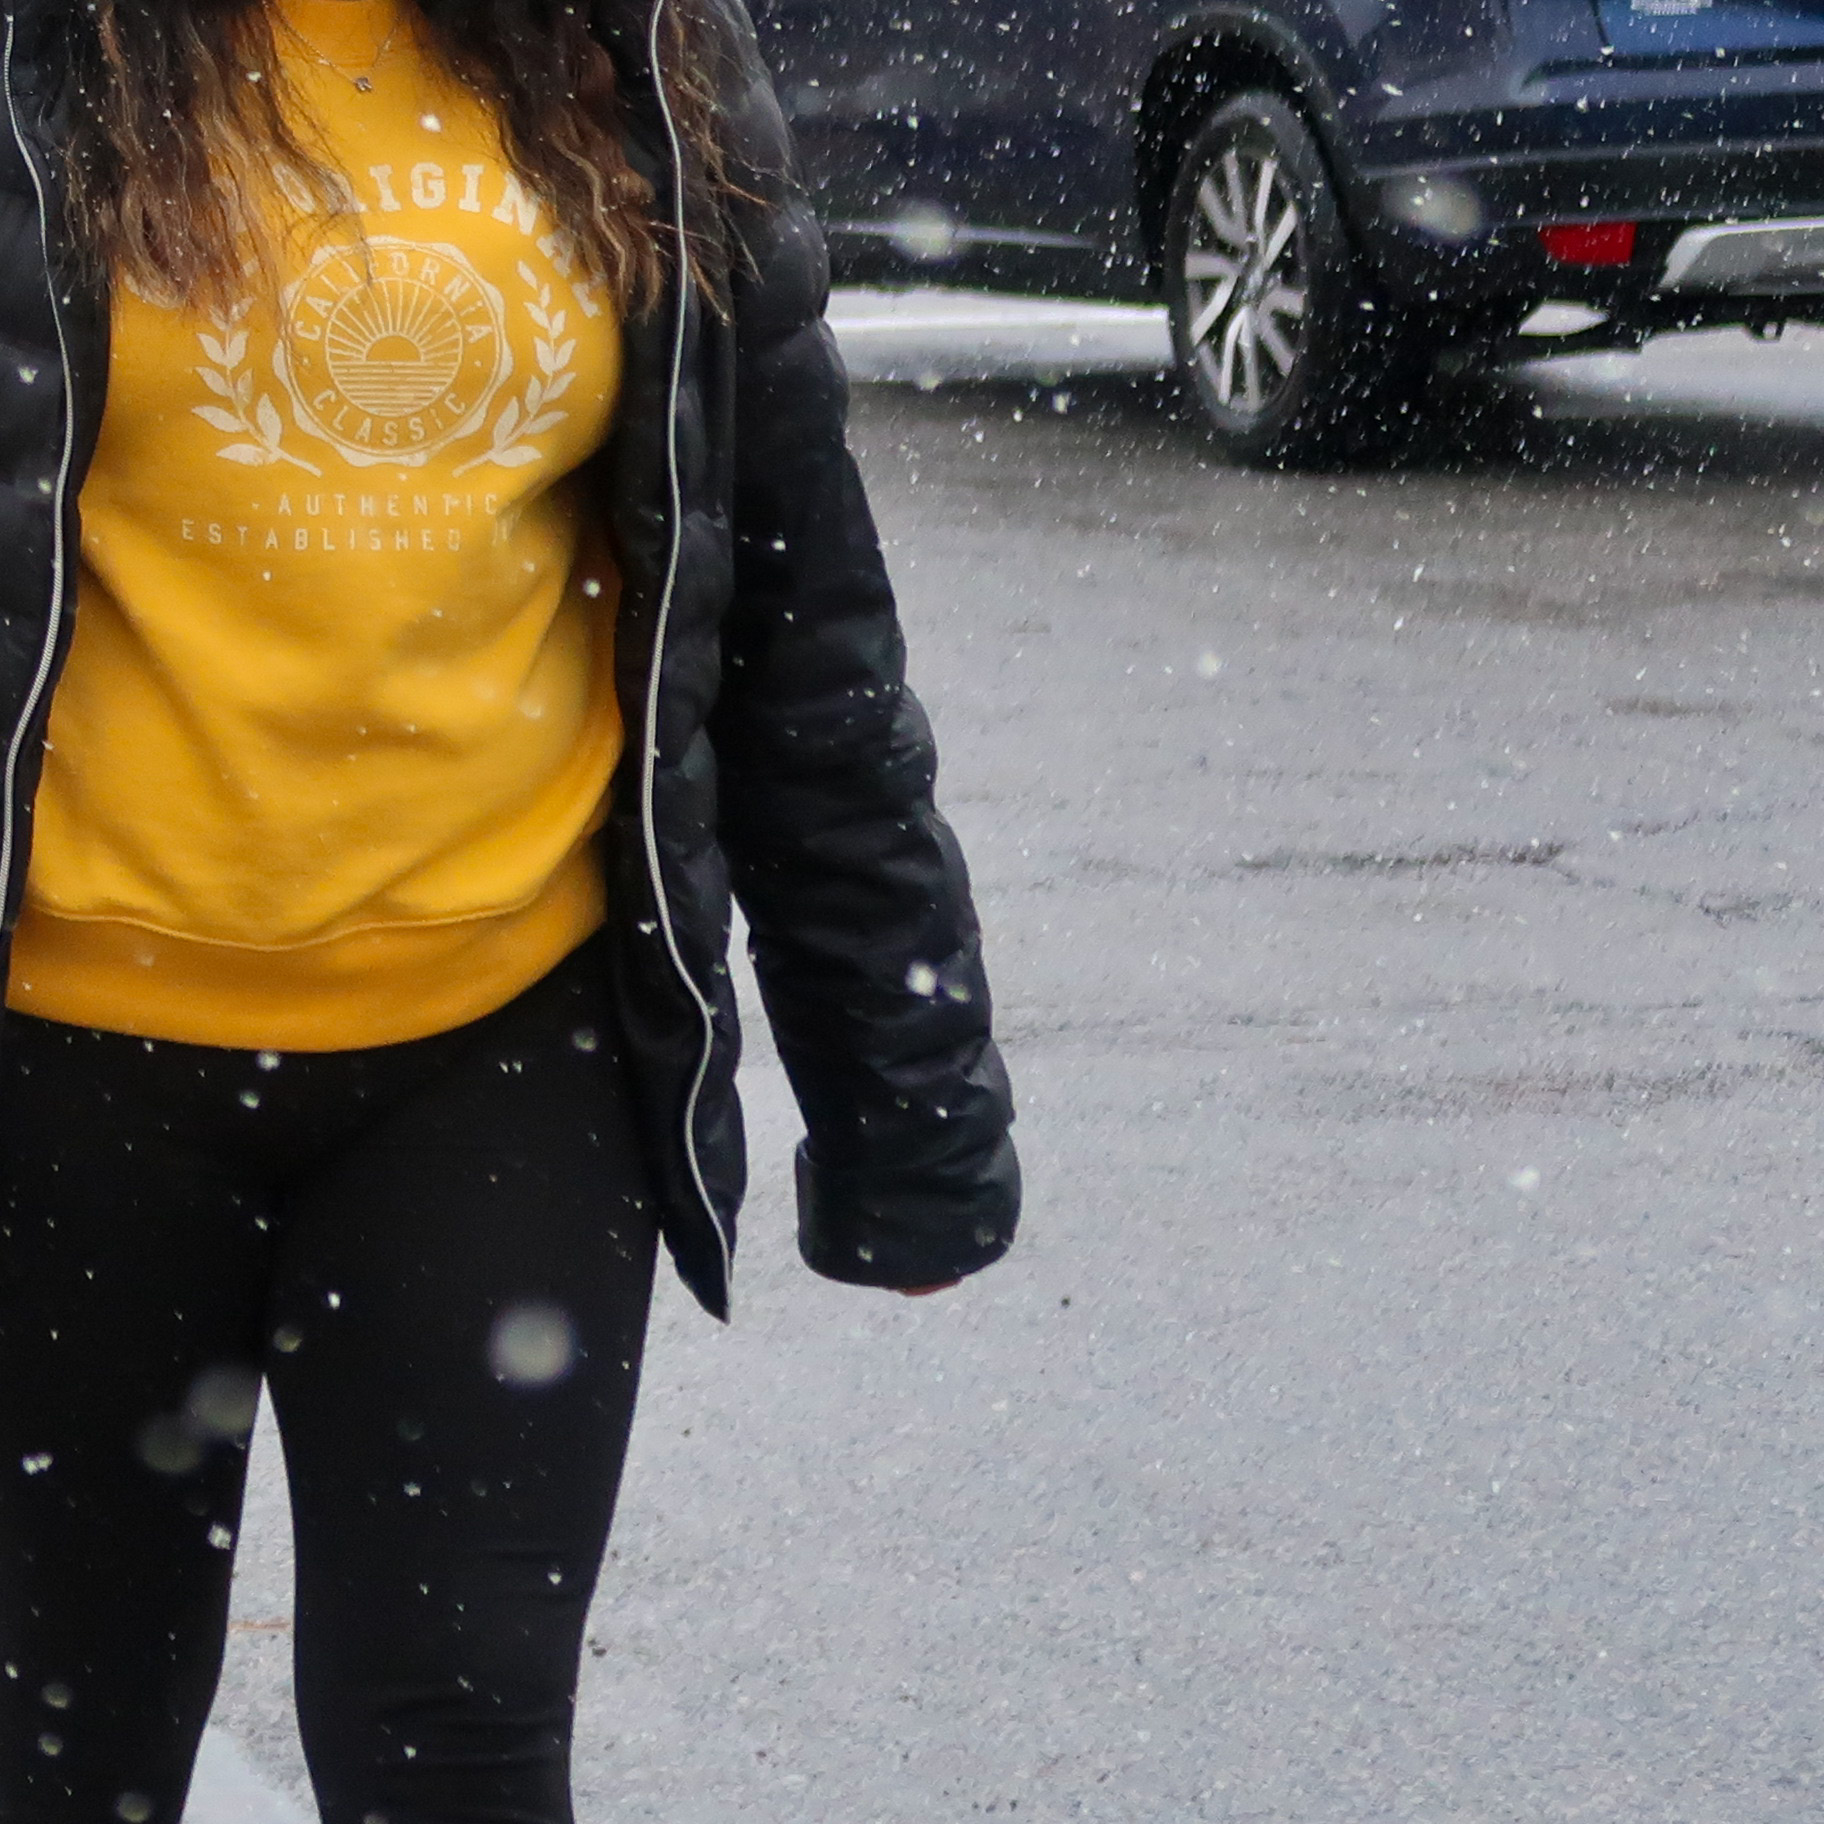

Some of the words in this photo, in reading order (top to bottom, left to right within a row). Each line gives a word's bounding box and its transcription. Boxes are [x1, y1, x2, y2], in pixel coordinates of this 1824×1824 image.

[313, 389, 466, 447] CLASSIC
[277, 492, 498, 518] AUTHENTIC
[181, 518, 462, 552] ESTABLISHED
